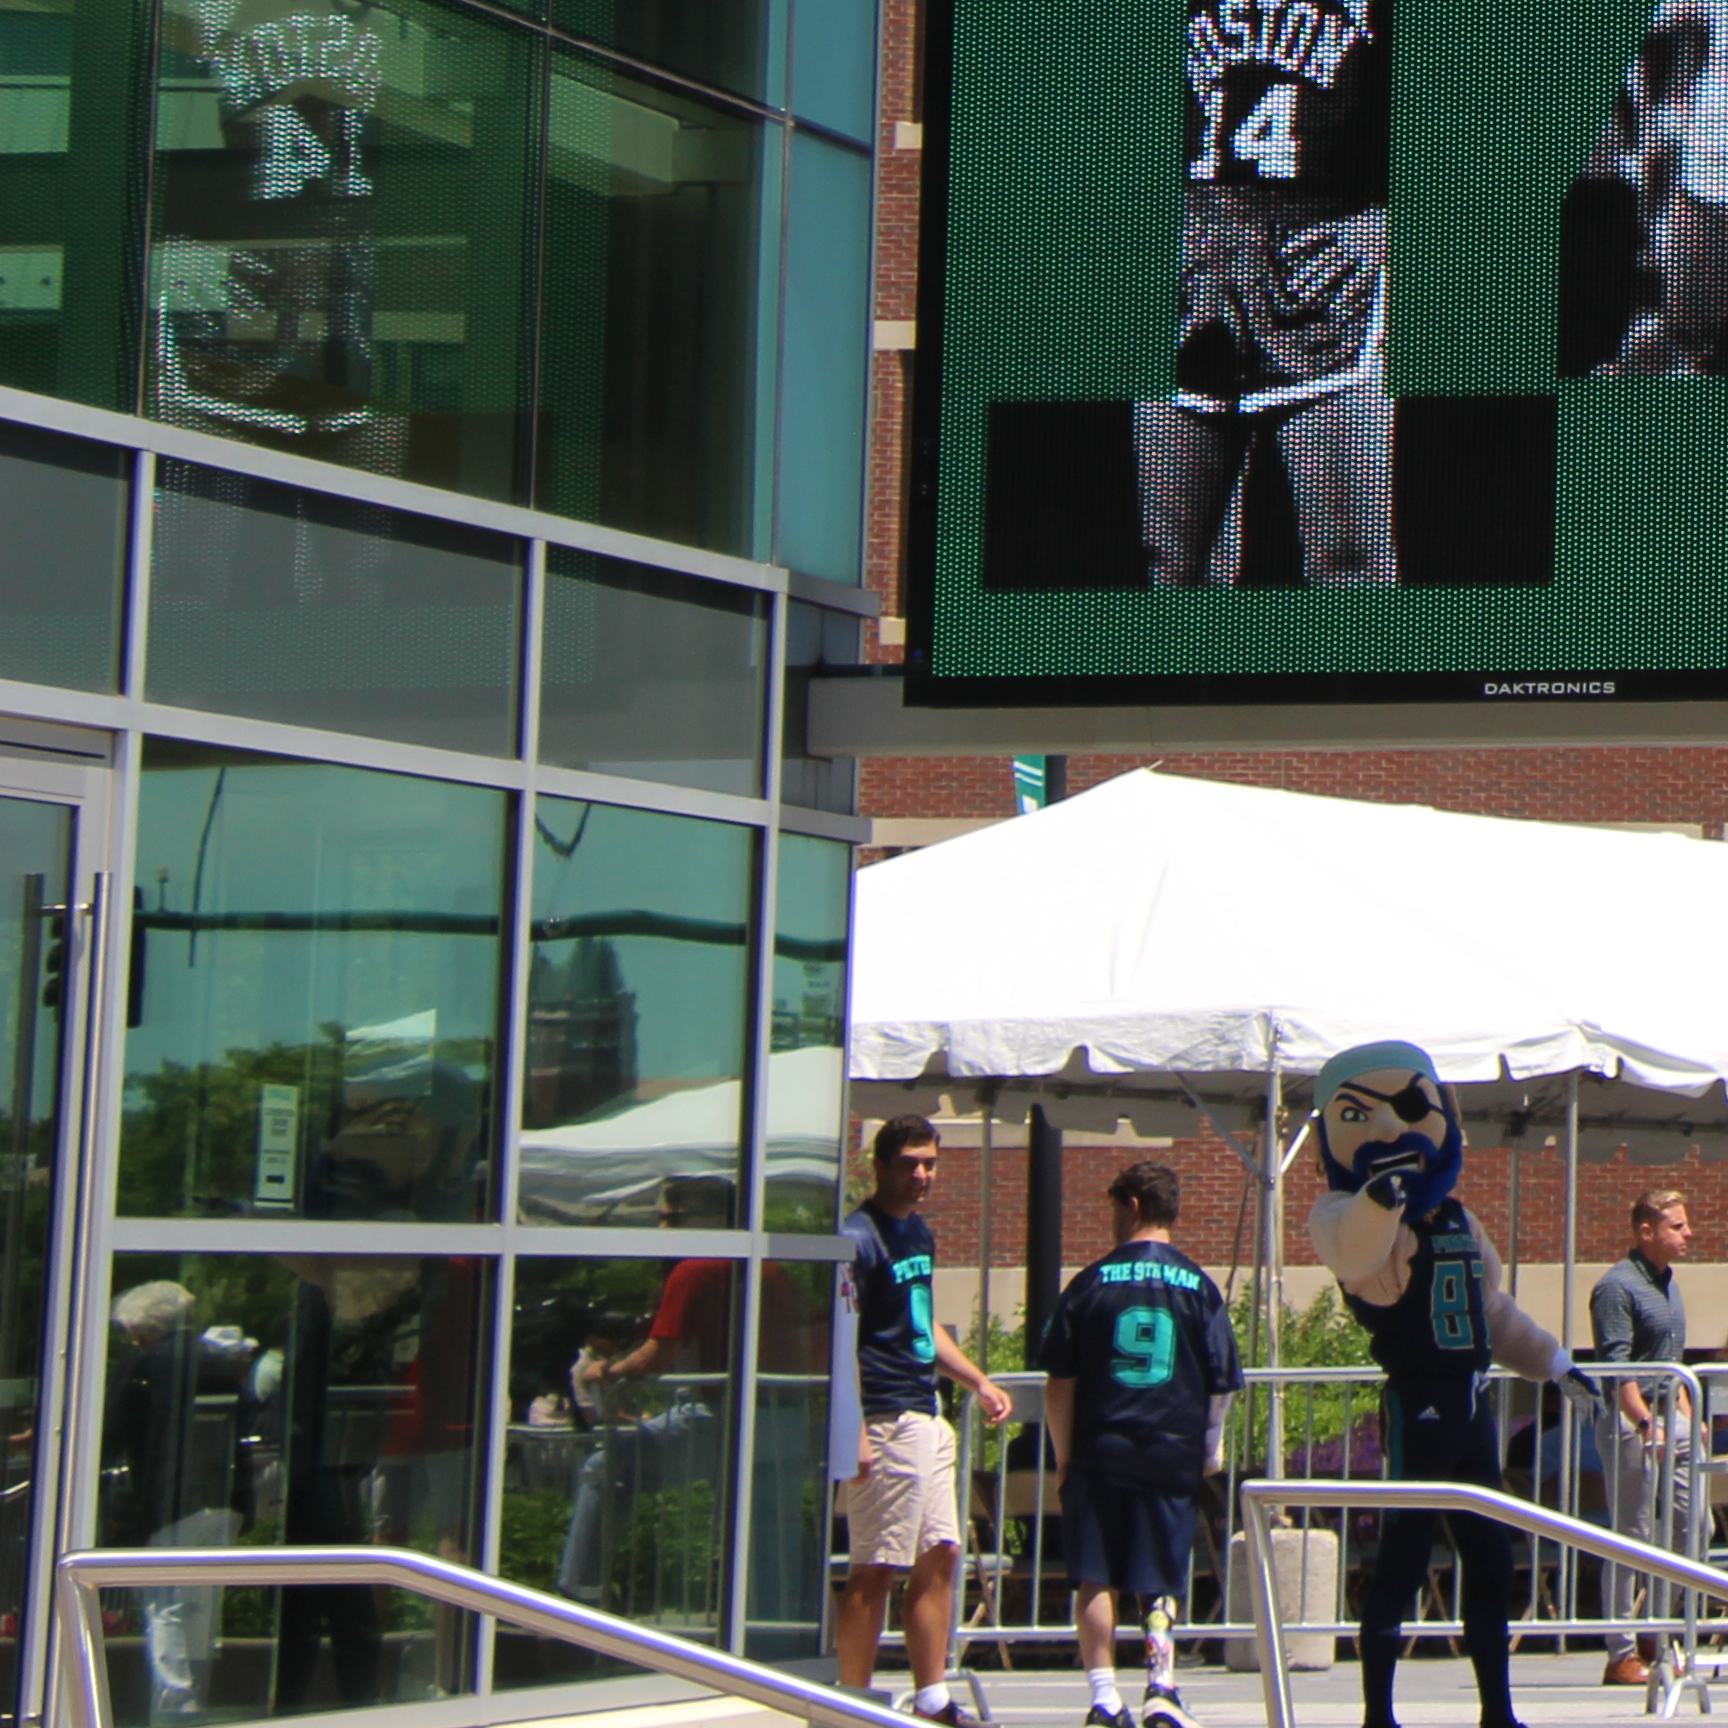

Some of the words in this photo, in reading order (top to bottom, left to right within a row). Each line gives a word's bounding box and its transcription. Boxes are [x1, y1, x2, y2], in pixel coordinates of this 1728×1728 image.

[1484, 682, 1616, 695] DAKTRONICS
[1100, 1262, 1133, 1283] THE
[1163, 1264, 1201, 1291] MAN
[1111, 1304, 1178, 1390] 9
